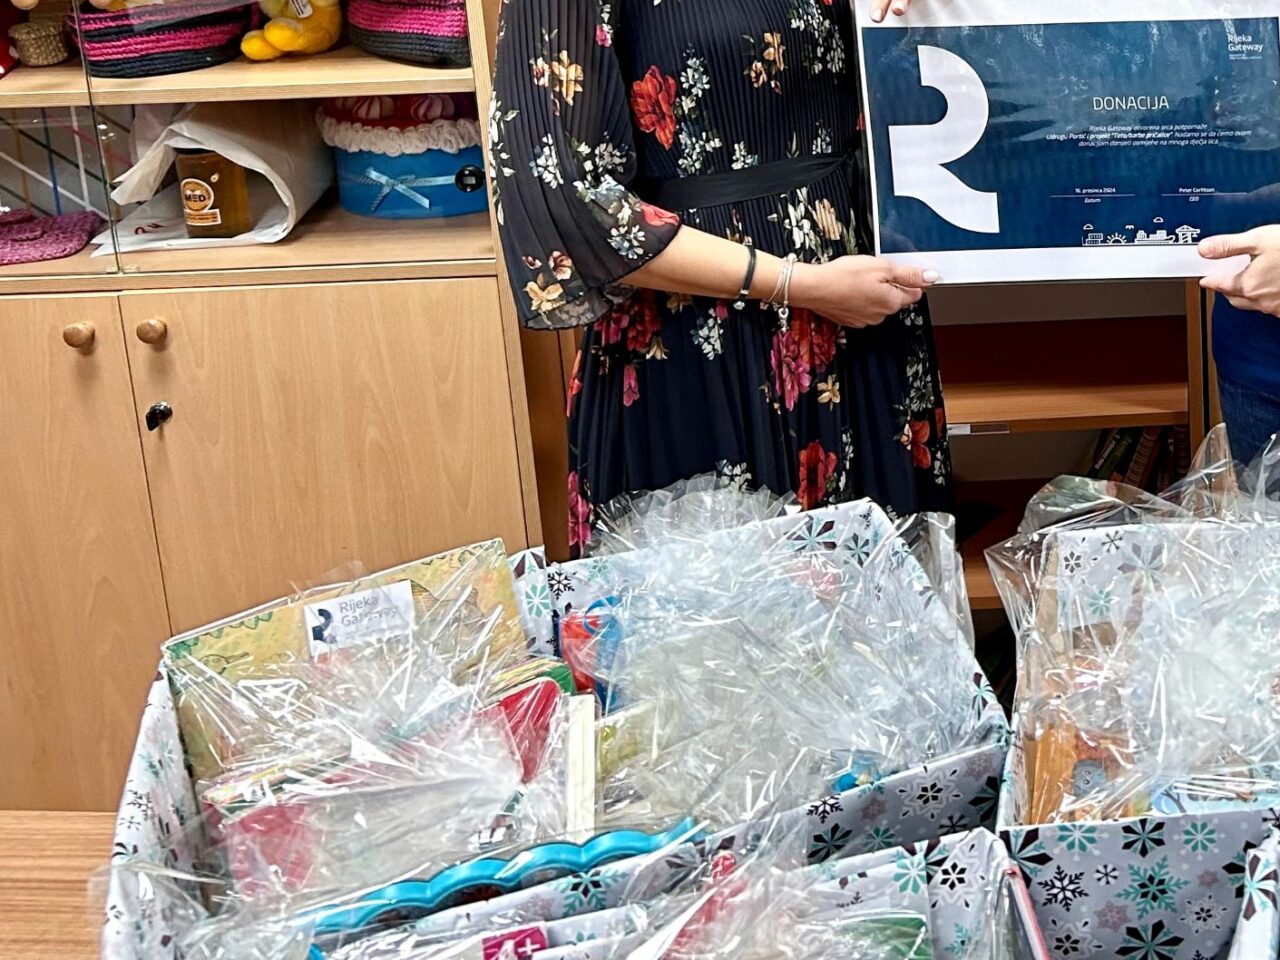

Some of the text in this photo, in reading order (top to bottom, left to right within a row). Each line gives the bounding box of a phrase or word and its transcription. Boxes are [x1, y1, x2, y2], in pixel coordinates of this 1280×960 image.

[1227, 34, 1251, 43] Rijeka
[1227, 43, 1263, 52] Gateway
[1093, 95, 1169, 111] DONACIJA
[184, 193, 205, 201] MED
[339, 595, 378, 613] Rijeka
